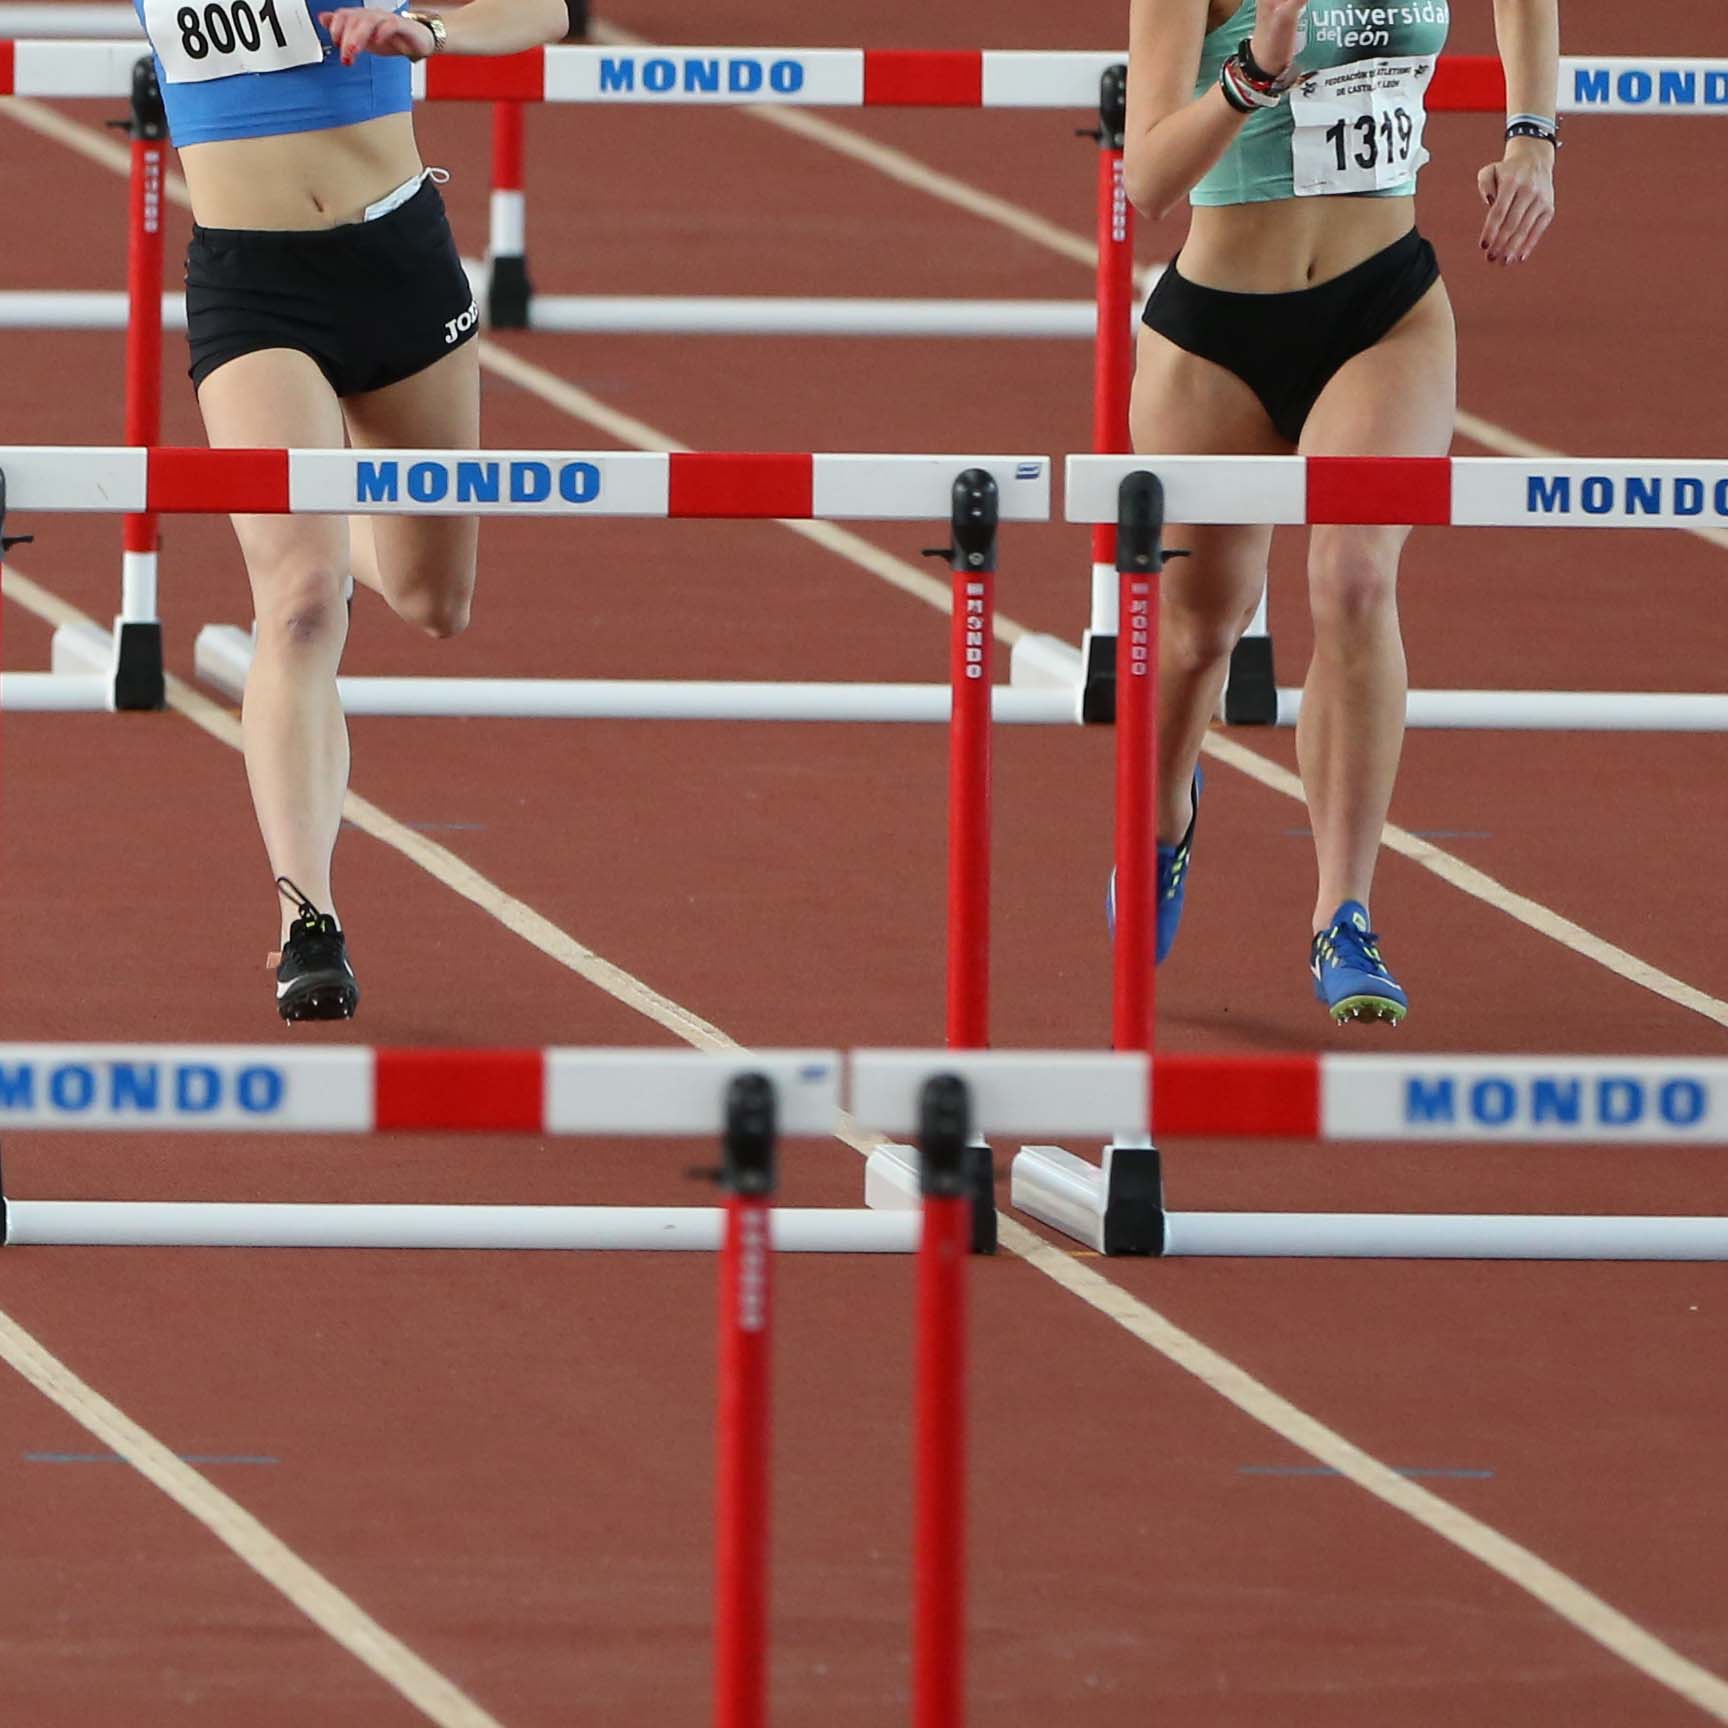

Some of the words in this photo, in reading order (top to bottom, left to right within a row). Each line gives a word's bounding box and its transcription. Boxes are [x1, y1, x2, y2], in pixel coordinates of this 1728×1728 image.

[599, 57, 805, 94] MONDO
[1325, 70, 1369, 87] FEDERACIÓN
[1336, 87, 1347, 97] DE
[1347, 83, 1376, 95] CASTIL
[1574, 69, 1728, 105] MOND
[1325, 107, 1414, 172] 1319
[445, 300, 478, 344] JO
[357, 461, 602, 504] MONDO
[1406, 1076, 1708, 1127] MONDO
